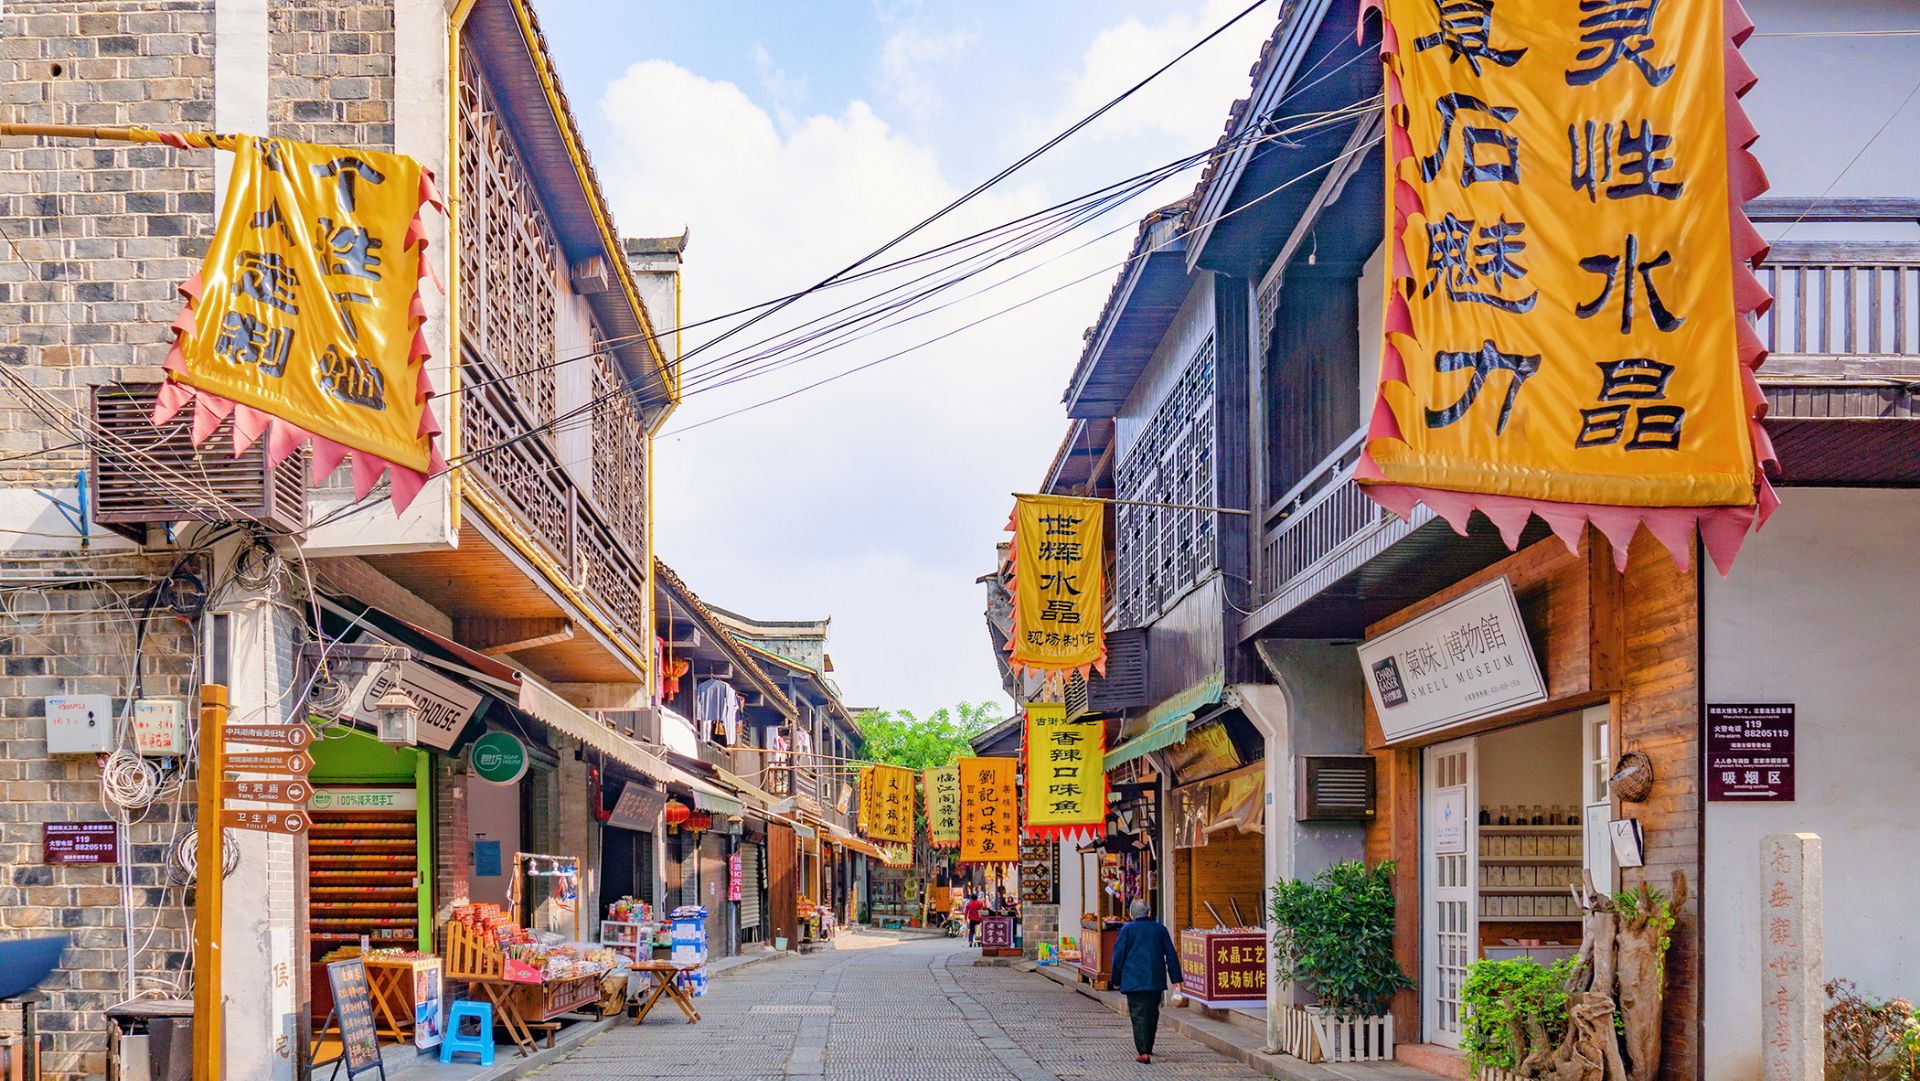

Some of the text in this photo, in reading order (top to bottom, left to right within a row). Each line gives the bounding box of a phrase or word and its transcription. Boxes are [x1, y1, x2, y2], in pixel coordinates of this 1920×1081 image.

[1027, 630, 1095, 647] 现场制作
[1411, 678, 1448, 700] SMELL
[1456, 654, 1515, 684] MUSEUM
[400, 686, 461, 731] APHOUSE
[1745, 720, 1762, 728] 119
[1744, 730, 1789, 738] 88205119
[1049, 731, 1084, 814] 香辣口味魚
[1722, 771, 1781, 784] 吸烟区
[236, 812, 277, 824] 卫生间
[978, 769, 999, 854] 劉記口味魚
[75, 835, 90, 843] 119
[1217, 946, 1265, 964] 水晶工艺
[1217, 971, 1266, 989] 现场制作
